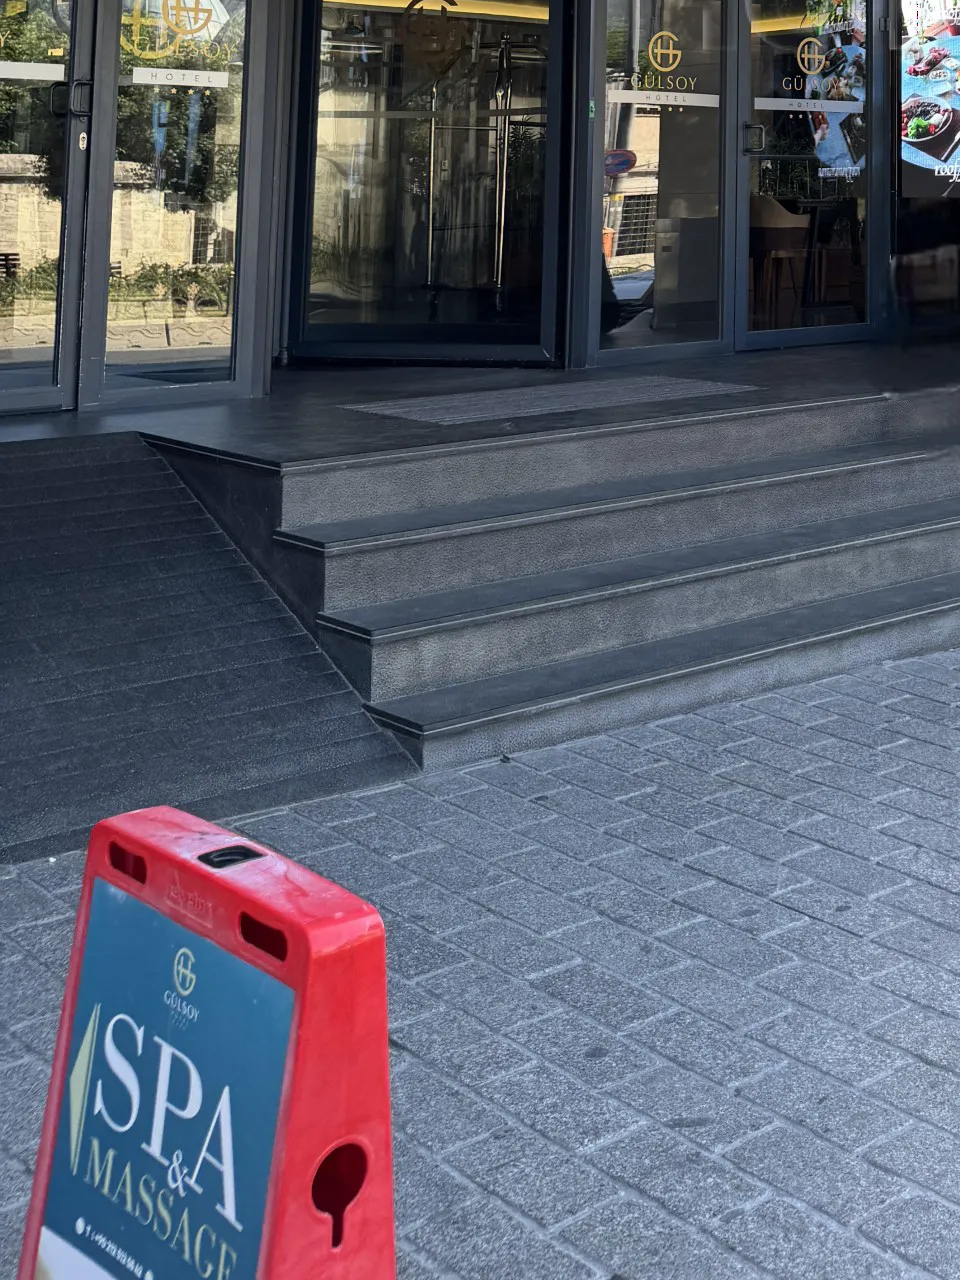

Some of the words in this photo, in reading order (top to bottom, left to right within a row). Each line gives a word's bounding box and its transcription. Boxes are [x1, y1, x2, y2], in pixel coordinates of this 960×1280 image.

[151, 72, 213, 84] HOTEL
[630, 71, 697, 91] GÜLSOY
[782, 75, 840, 93] GÜSOY
[645, 93, 687, 103] HOTEL
[93, 1013, 244, 1233] SPA
[167, 1148, 189, 1198] &
[83, 1136, 238, 1280] MASSAGE
